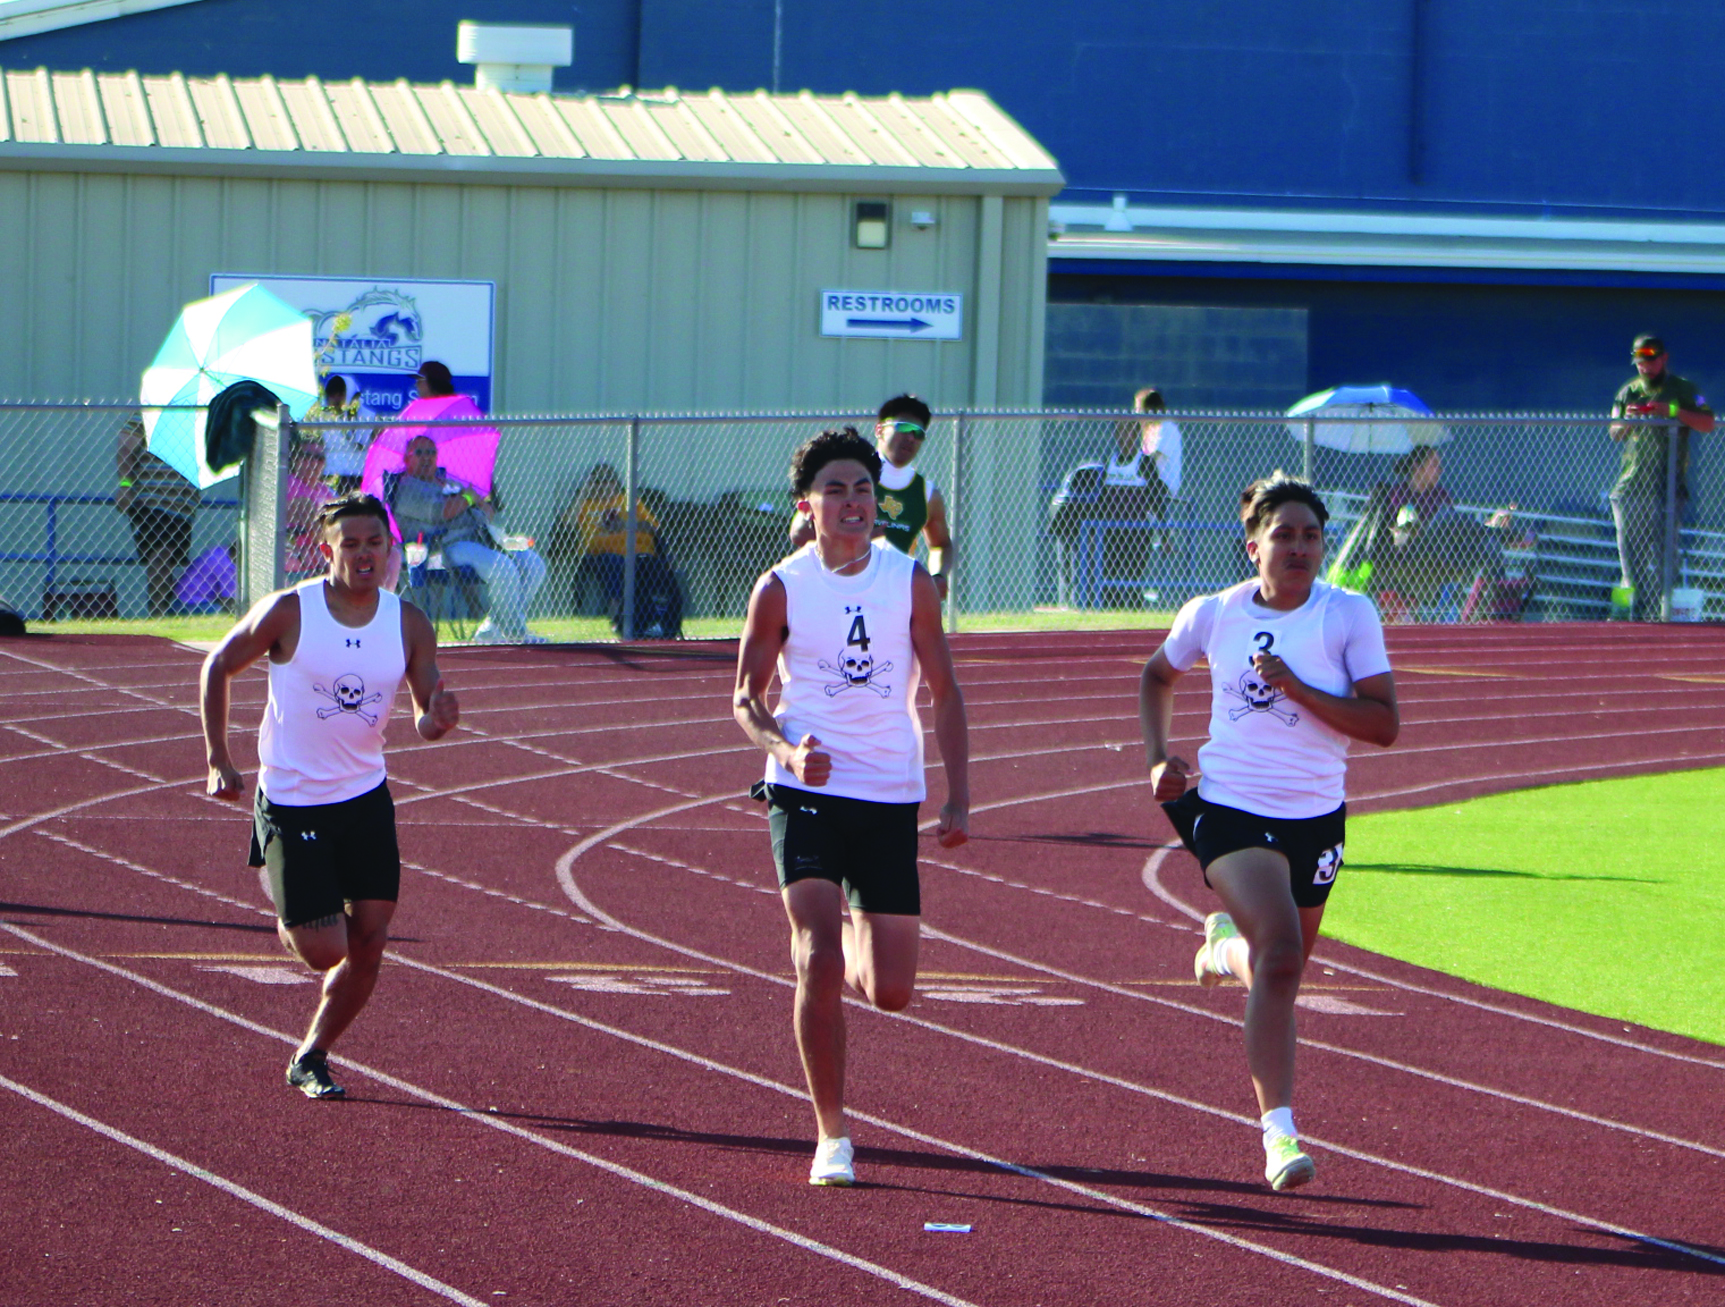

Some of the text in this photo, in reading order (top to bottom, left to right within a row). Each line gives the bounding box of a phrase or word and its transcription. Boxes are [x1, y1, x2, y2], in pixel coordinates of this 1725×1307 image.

[827, 295, 955, 314] RESTROOMS
[318, 348, 419, 367] STANGS
[847, 615, 871, 652] 4
[1249, 631, 1275, 668] 3
